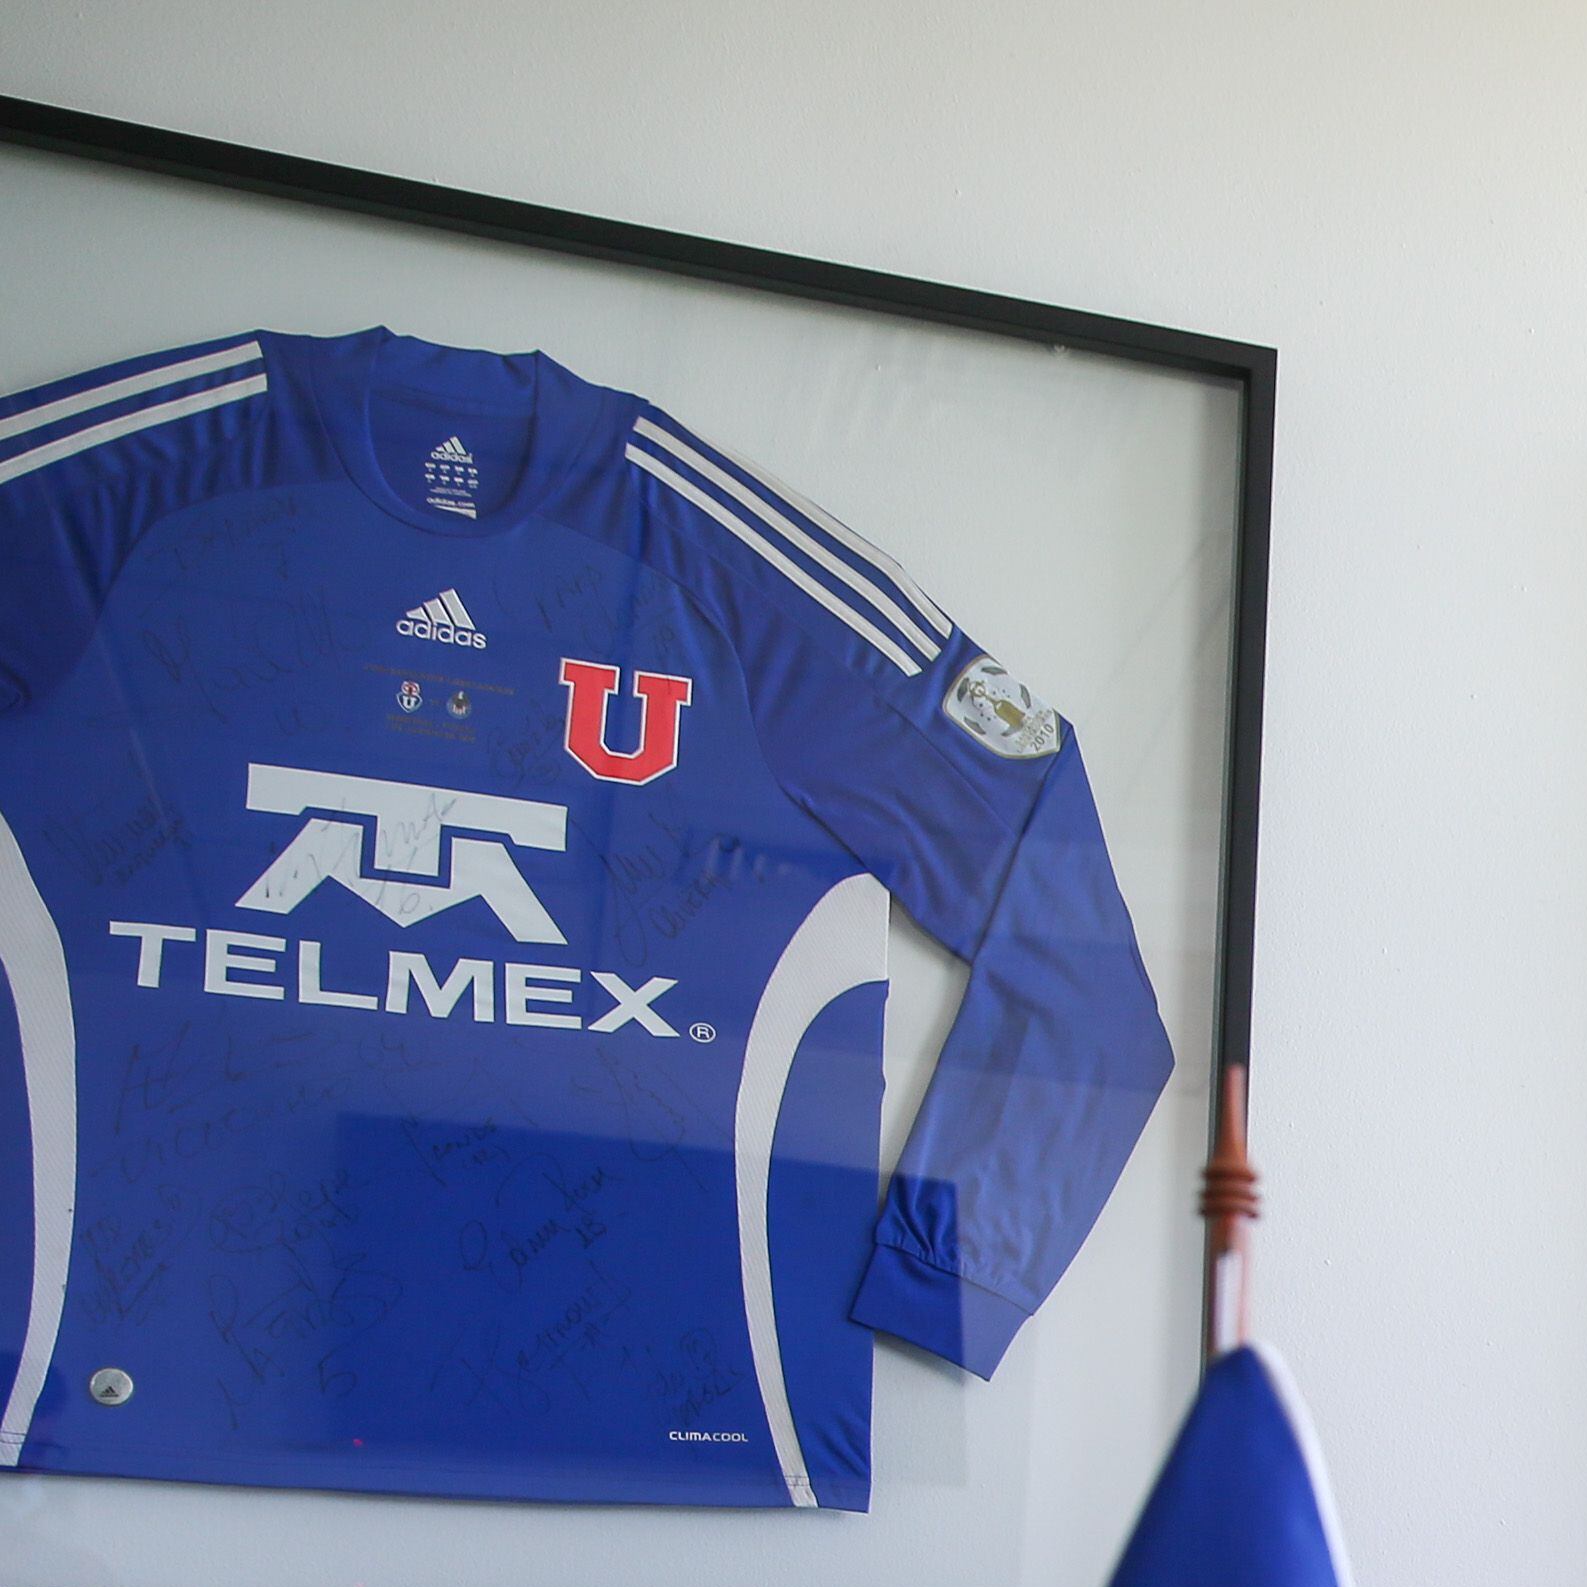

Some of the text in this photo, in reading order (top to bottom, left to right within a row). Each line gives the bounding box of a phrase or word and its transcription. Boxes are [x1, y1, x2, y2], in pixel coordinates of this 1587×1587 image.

[396, 617, 487, 650] adidas
[558, 656, 694, 787] U
[1030, 722, 1055, 752] 2010
[108, 919, 680, 1038] TELMEX
